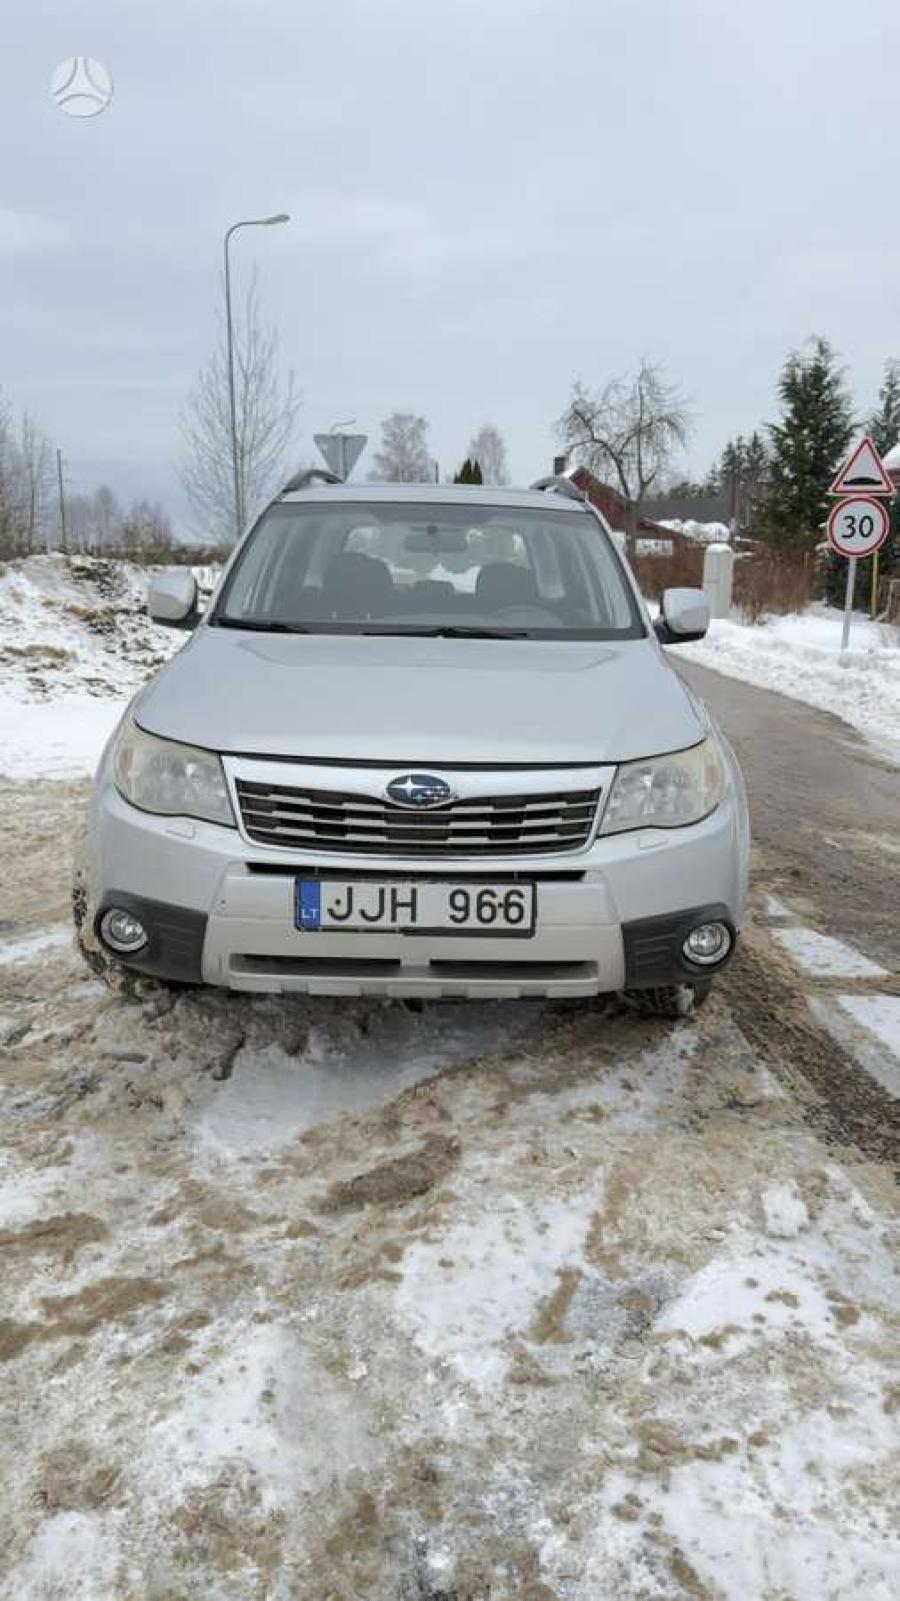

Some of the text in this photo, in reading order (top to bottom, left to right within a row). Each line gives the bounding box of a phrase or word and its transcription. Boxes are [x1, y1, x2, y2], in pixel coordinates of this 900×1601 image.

[841, 515, 874, 539] 30
[301, 908, 319, 919] LT
[326, 886, 525, 925] JJH 966
